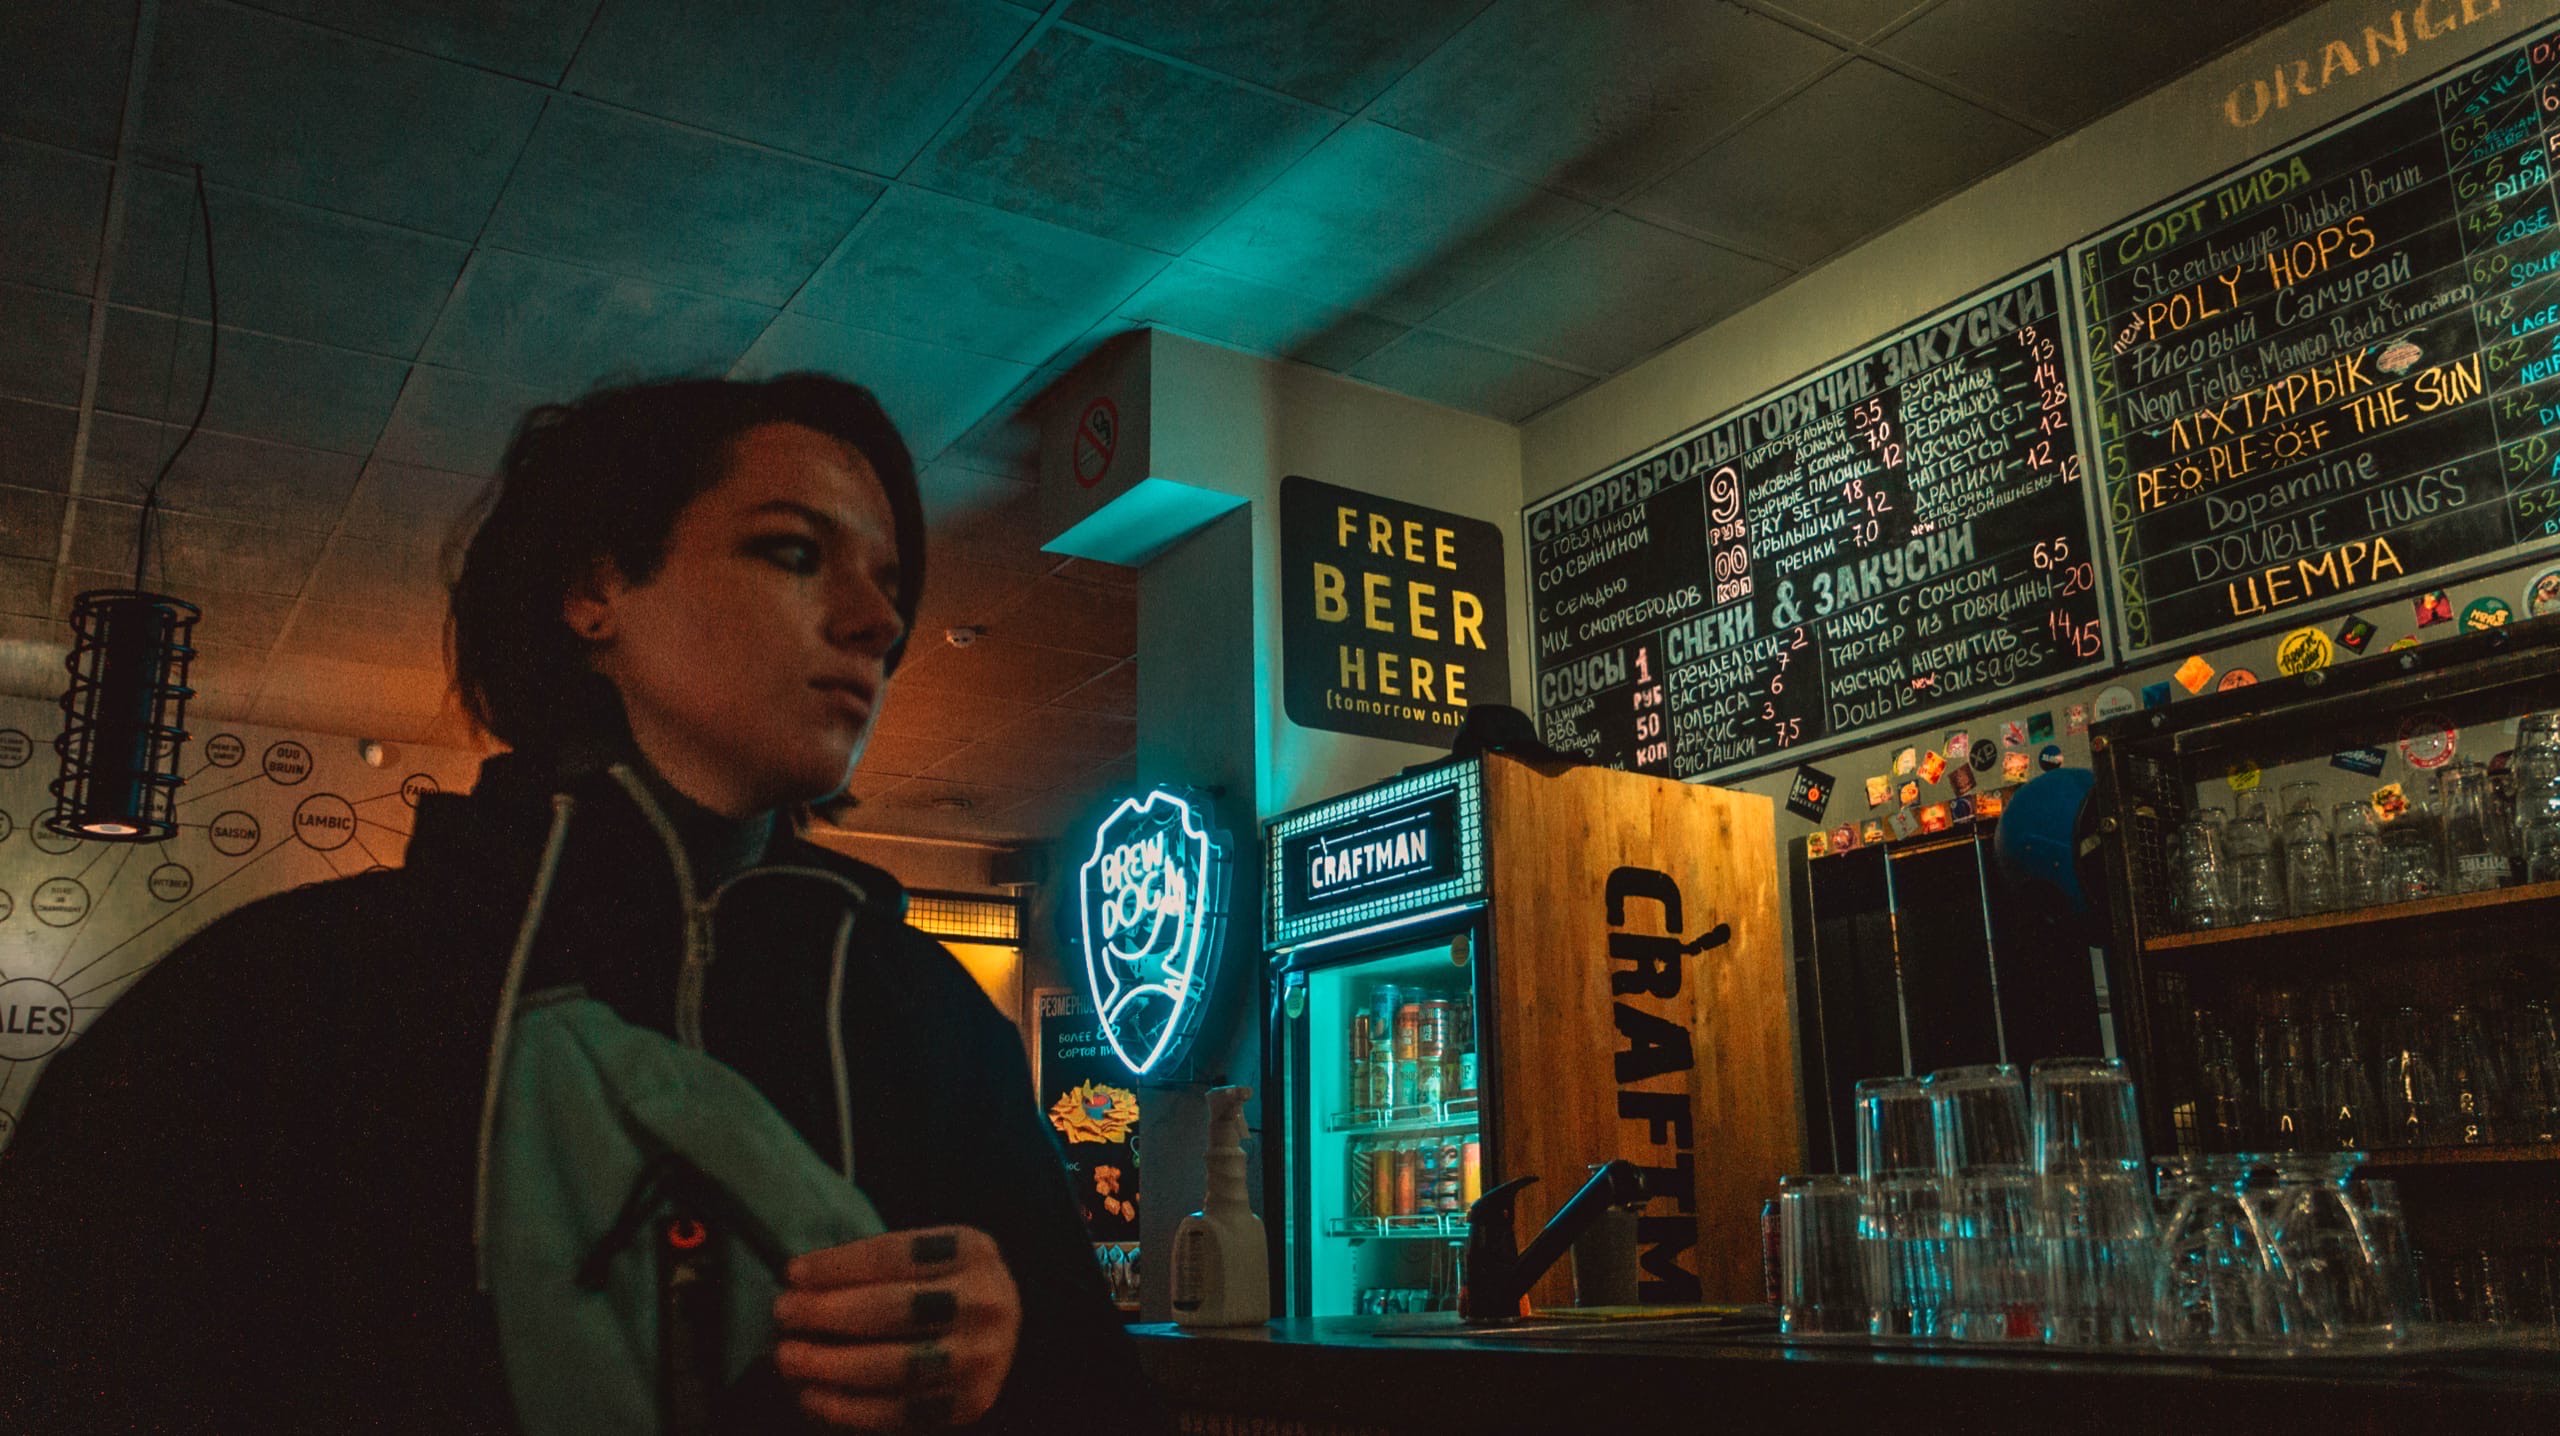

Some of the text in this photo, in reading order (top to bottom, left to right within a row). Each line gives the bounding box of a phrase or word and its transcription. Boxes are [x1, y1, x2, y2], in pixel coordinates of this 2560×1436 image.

[2119, 156, 2311, 265] СОРТ ПИВА
[2495, 165, 2546, 200] DIPA
[2085, 164, 2424, 321] 1 Steenbrugge Dubbel Bruin
[2496, 206, 2550, 244] GOSE
[2089, 215, 2376, 364] 2 new POLY HOPS
[2032, 338, 2054, 361] 13
[2092, 251, 2411, 398] 3 Рисовый Самурай
[1743, 281, 2044, 450] ГОРЯЧИЕ ЗАКУСКИ
[1900, 326, 2036, 402] БУРГИК 13
[2097, 402, 2119, 440] 4
[2127, 382, 2182, 428] Neon
[2330, 306, 2386, 350] Peach
[1905, 364, 2056, 443] РЕБРЫШКИ 14
[1906, 383, 2068, 471] МЯСНОЙ СЕТ 28
[1744, 412, 1847, 471] КАРТОФЕЛЬНЫЕ
[1795, 430, 1847, 465] ДОЛЬКИ
[1908, 411, 2068, 490] НАГГЕТСЫ 12
[2107, 443, 2127, 480] 5
[2111, 481, 2131, 525] 6
[2340, 383, 2409, 433] THE
[2414, 352, 2482, 412] SUN
[1532, 424, 1737, 541] СМОРРЕБРОДЫ
[1710, 466, 1740, 524] 9
[1749, 443, 1855, 504] ЛУКОВЫЕ КОЛЬЦА
[1749, 443, 1903, 522] СЫРНЫЕ ПАЛОЧКИ 12
[1914, 441, 2053, 514] ДРАНИКИ 12
[2059, 455, 2080, 484] 12
[1539, 504, 1647, 564] С ГОВЯДИНОЙ
[1710, 519, 1746, 546] РУБ
[1751, 479, 1863, 542] FRY SET 18
[1753, 491, 1892, 560] КРЫЛЫШКИ 12
[1919, 485, 1995, 524] СЕЛЕДОЧКА
[2115, 452, 2379, 566] 7 Dopamine
[1338, 505, 1457, 570] FREE
[1715, 544, 1747, 582] 00
[1776, 539, 1835, 577] ГРЕНКИ
[2120, 467, 2466, 607] 8 DOUBLE HUGS
[1313, 562, 1487, 650] BEER
[1538, 567, 1563, 592] СО
[1556, 577, 1628, 616] СЕЛЬДЬЮ
[1667, 520, 1975, 665] СНЕКИ & ЗАКУСКИ
[1717, 576, 1752, 604] КОП
[1826, 602, 1888, 640] НАЧОС
[1899, 595, 1910, 616] С
[1918, 565, 1998, 610] СОУСОМ
[2127, 537, 2404, 649] 9 ЦЕМРА
[1579, 585, 1701, 641] СМОРРЕБРОДОВ
[1791, 627, 1808, 650] 2
[1829, 562, 2094, 668] ТАРТАР ИЗ ГОВЯДИНЫ 20
[1339, 644, 1468, 707] HERE
[1541, 648, 1627, 707] СОУСЫ
[1635, 647, 1652, 685] 1
[1671, 652, 1790, 712] БАСТУРМА 7
[1830, 609, 2071, 700] МЯСНОЙ АПЕРИТИВ 14
[1832, 683, 1917, 730] Double
[1930, 642, 2043, 697] sausages
[2072, 620, 2101, 658] 15
[1327, 689, 1426, 721] (tomorrow
[1633, 685, 1662, 711] РУБ
[1637, 713, 1660, 741] 50
[1674, 674, 1784, 736] КОЛБАСА 6
[1676, 701, 1775, 753] АРАХИС 3
[1547, 720, 1577, 744] BBQ
[1637, 742, 1667, 766] КОП
[1674, 737, 1755, 777] ФИСТАШКИ
[269, 761, 304, 775] BRUIN
[214, 827, 257, 840] SAISON
[298, 813, 351, 831] LAMBIC
[1101, 830, 1164, 894] BREW
[1311, 828, 1428, 889] CRAFTMAN
[1058, 1031, 1092, 1043] БОЛЕЕ
[1058, 1046, 1096, 1059] СОРТОВ
